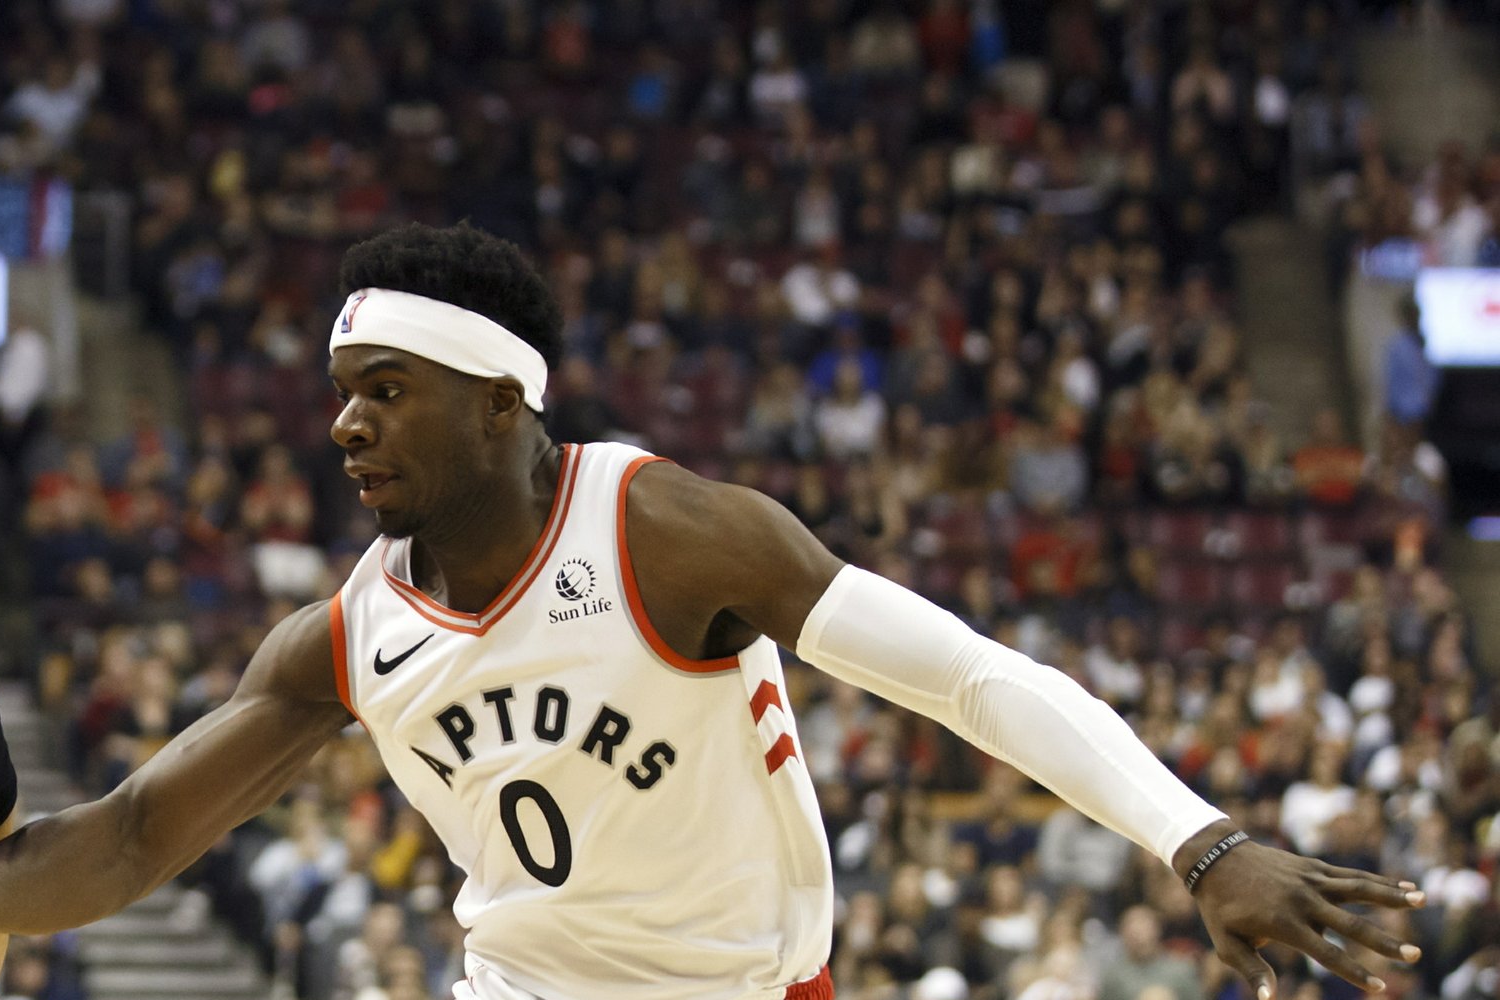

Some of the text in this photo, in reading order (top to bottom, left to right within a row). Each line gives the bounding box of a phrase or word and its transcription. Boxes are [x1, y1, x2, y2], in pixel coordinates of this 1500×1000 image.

[548, 597, 613, 624] Sun Life
[499, 779, 573, 888] 0
[1196, 848, 1221, 871] OVER
